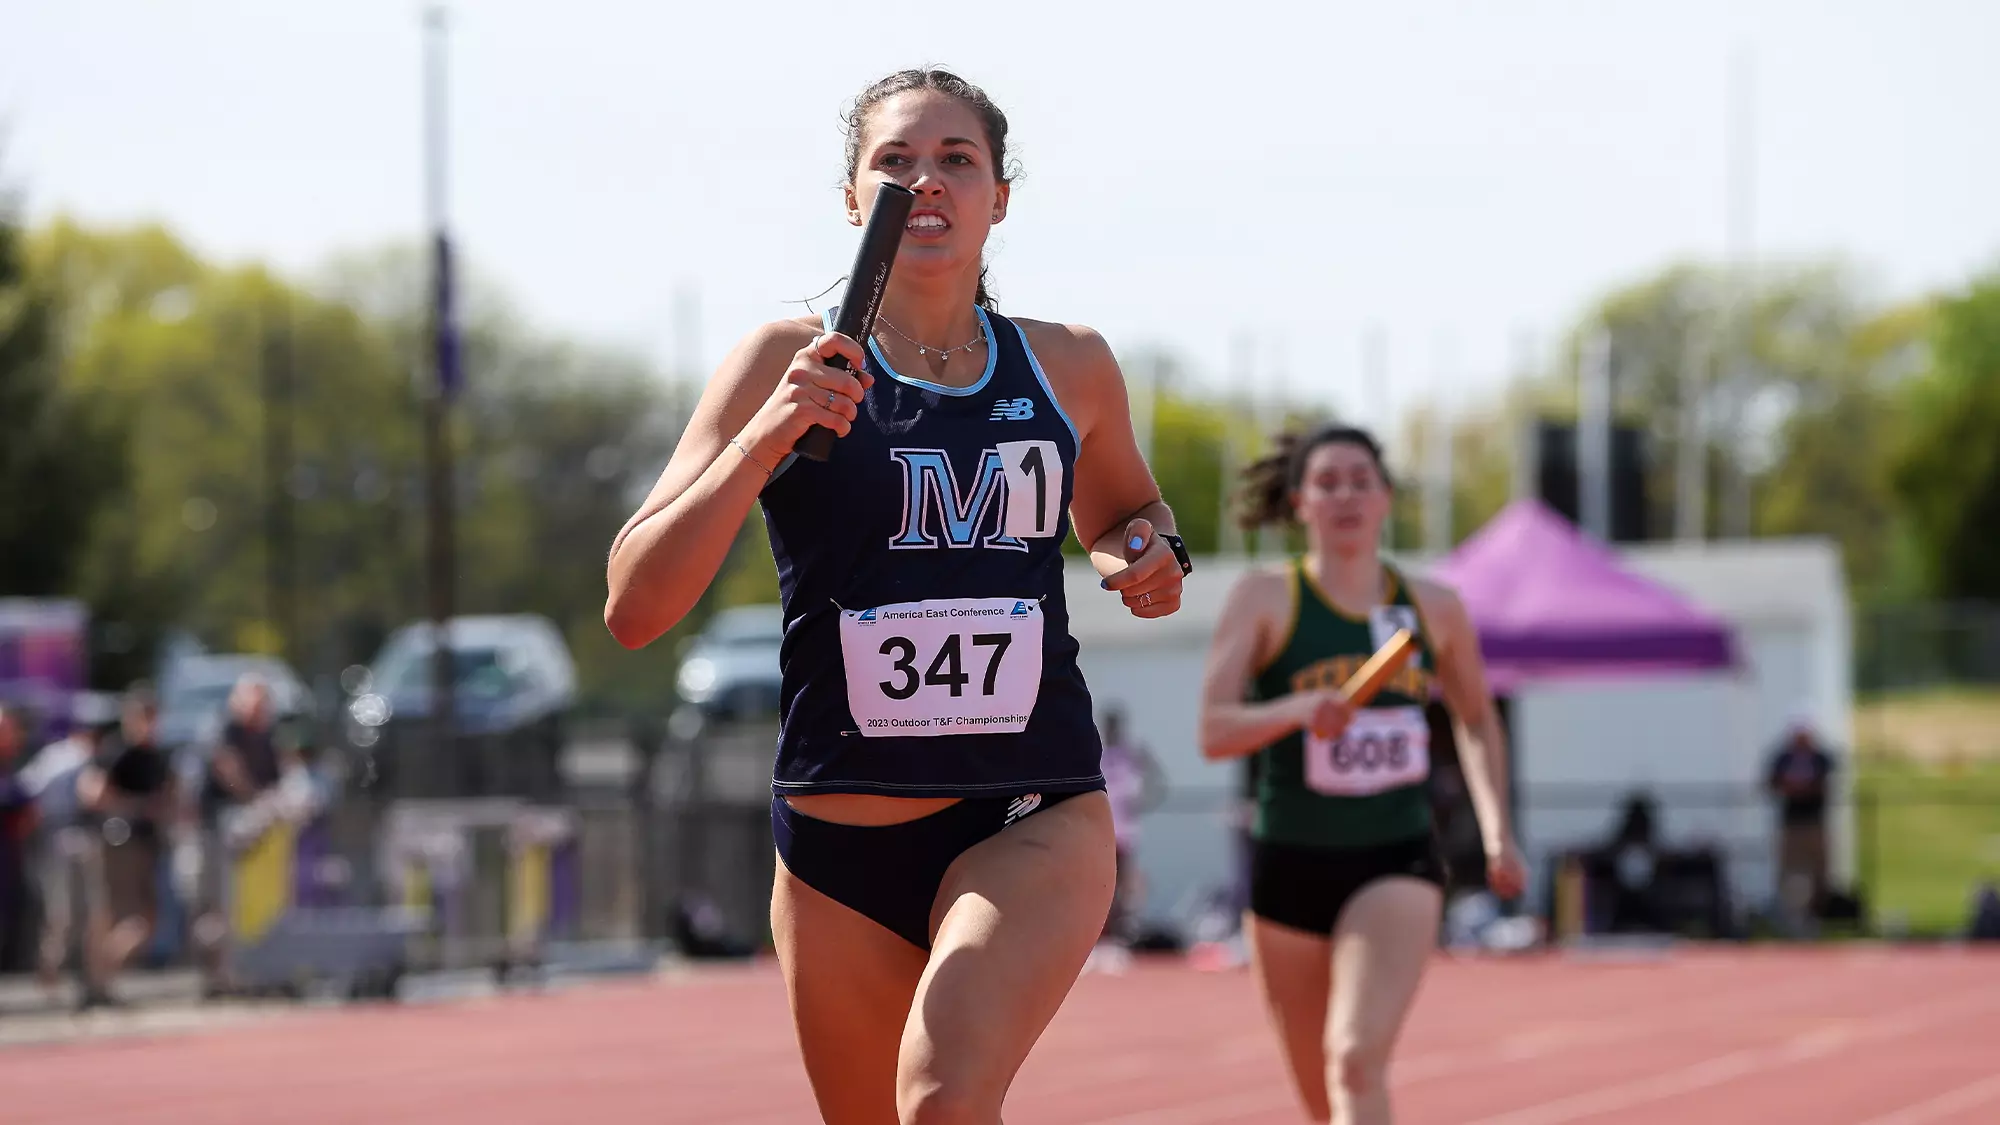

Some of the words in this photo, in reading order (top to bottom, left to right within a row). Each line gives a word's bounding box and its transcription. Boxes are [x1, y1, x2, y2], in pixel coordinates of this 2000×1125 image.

[889, 447, 1029, 553] M
[1019, 446, 1047, 532] 1
[882, 610, 923, 620] America
[926, 609, 948, 618] East
[950, 607, 1005, 617] Conference
[878, 633, 1012, 700] 347
[866, 718, 889, 728] 2023
[891, 718, 930, 727] Outdoor
[933, 717, 953, 726] T&F
[955, 714, 1028, 726] Championships
